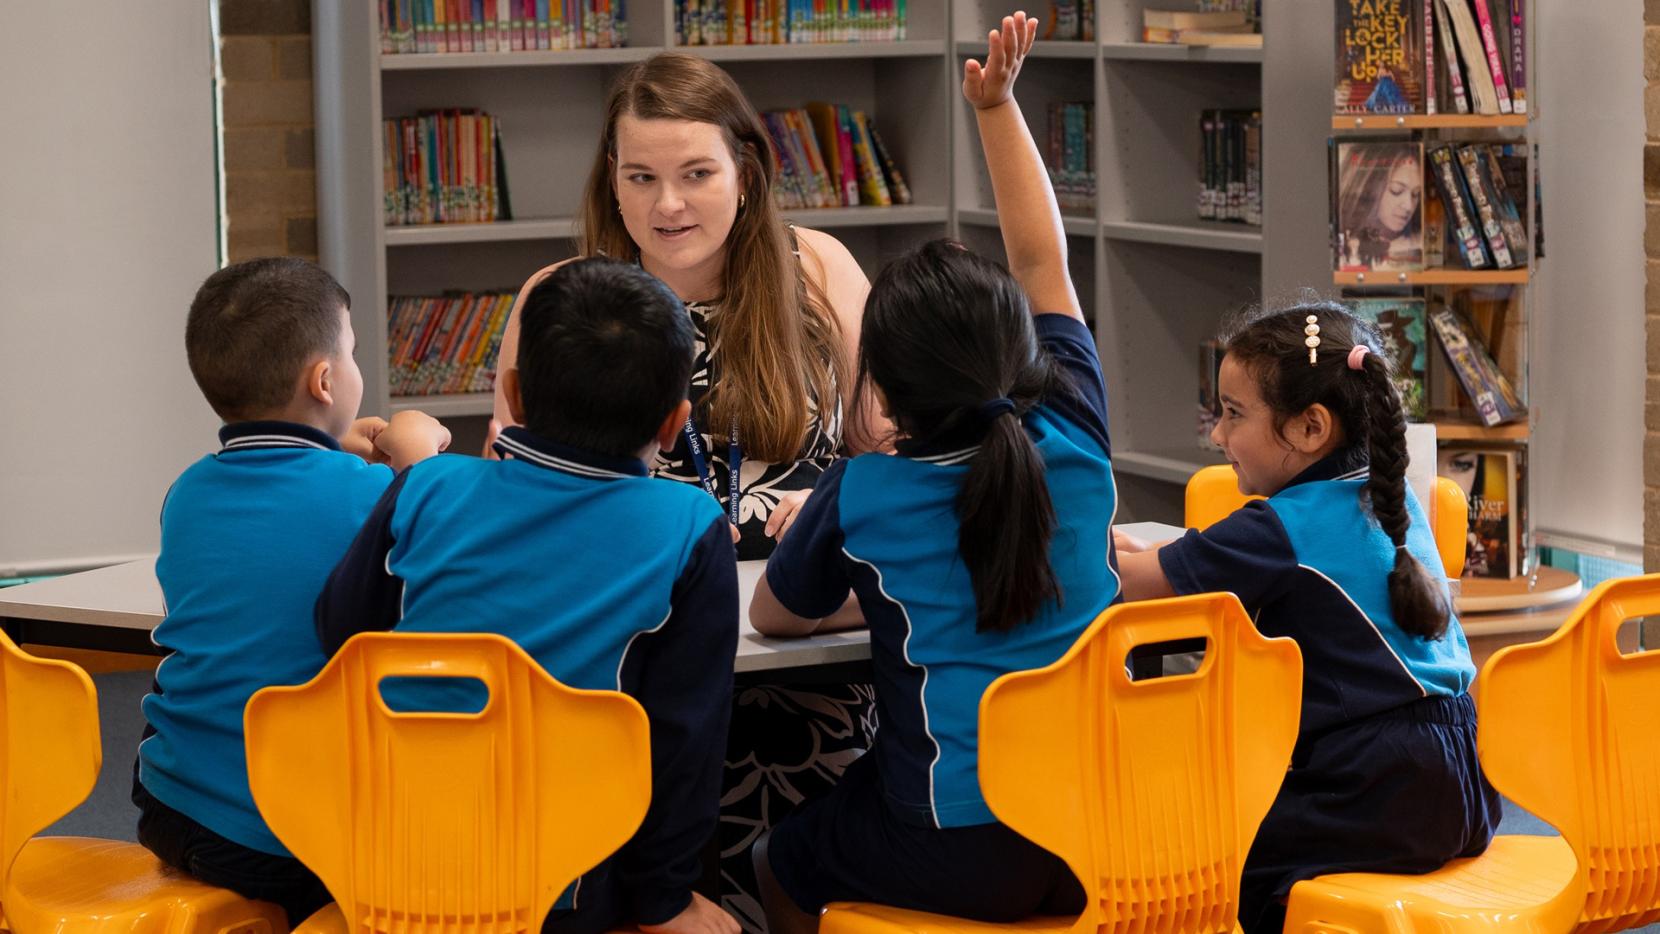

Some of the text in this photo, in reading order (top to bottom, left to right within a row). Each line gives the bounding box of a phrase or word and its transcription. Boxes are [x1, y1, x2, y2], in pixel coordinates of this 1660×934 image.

[1349, 0, 1401, 15] TAKE
[1353, 15, 1409, 34] THE KEY
[1345, 28, 1401, 49] LOCK
[1365, 46, 1405, 66] HER
[1513, 28, 1523, 72] DRAMA
[1374, 104, 1416, 113] CARTER
[689, 433, 701, 455] Links
[730, 469, 738, 490] Links
[1468, 511, 1501, 522] HARM
